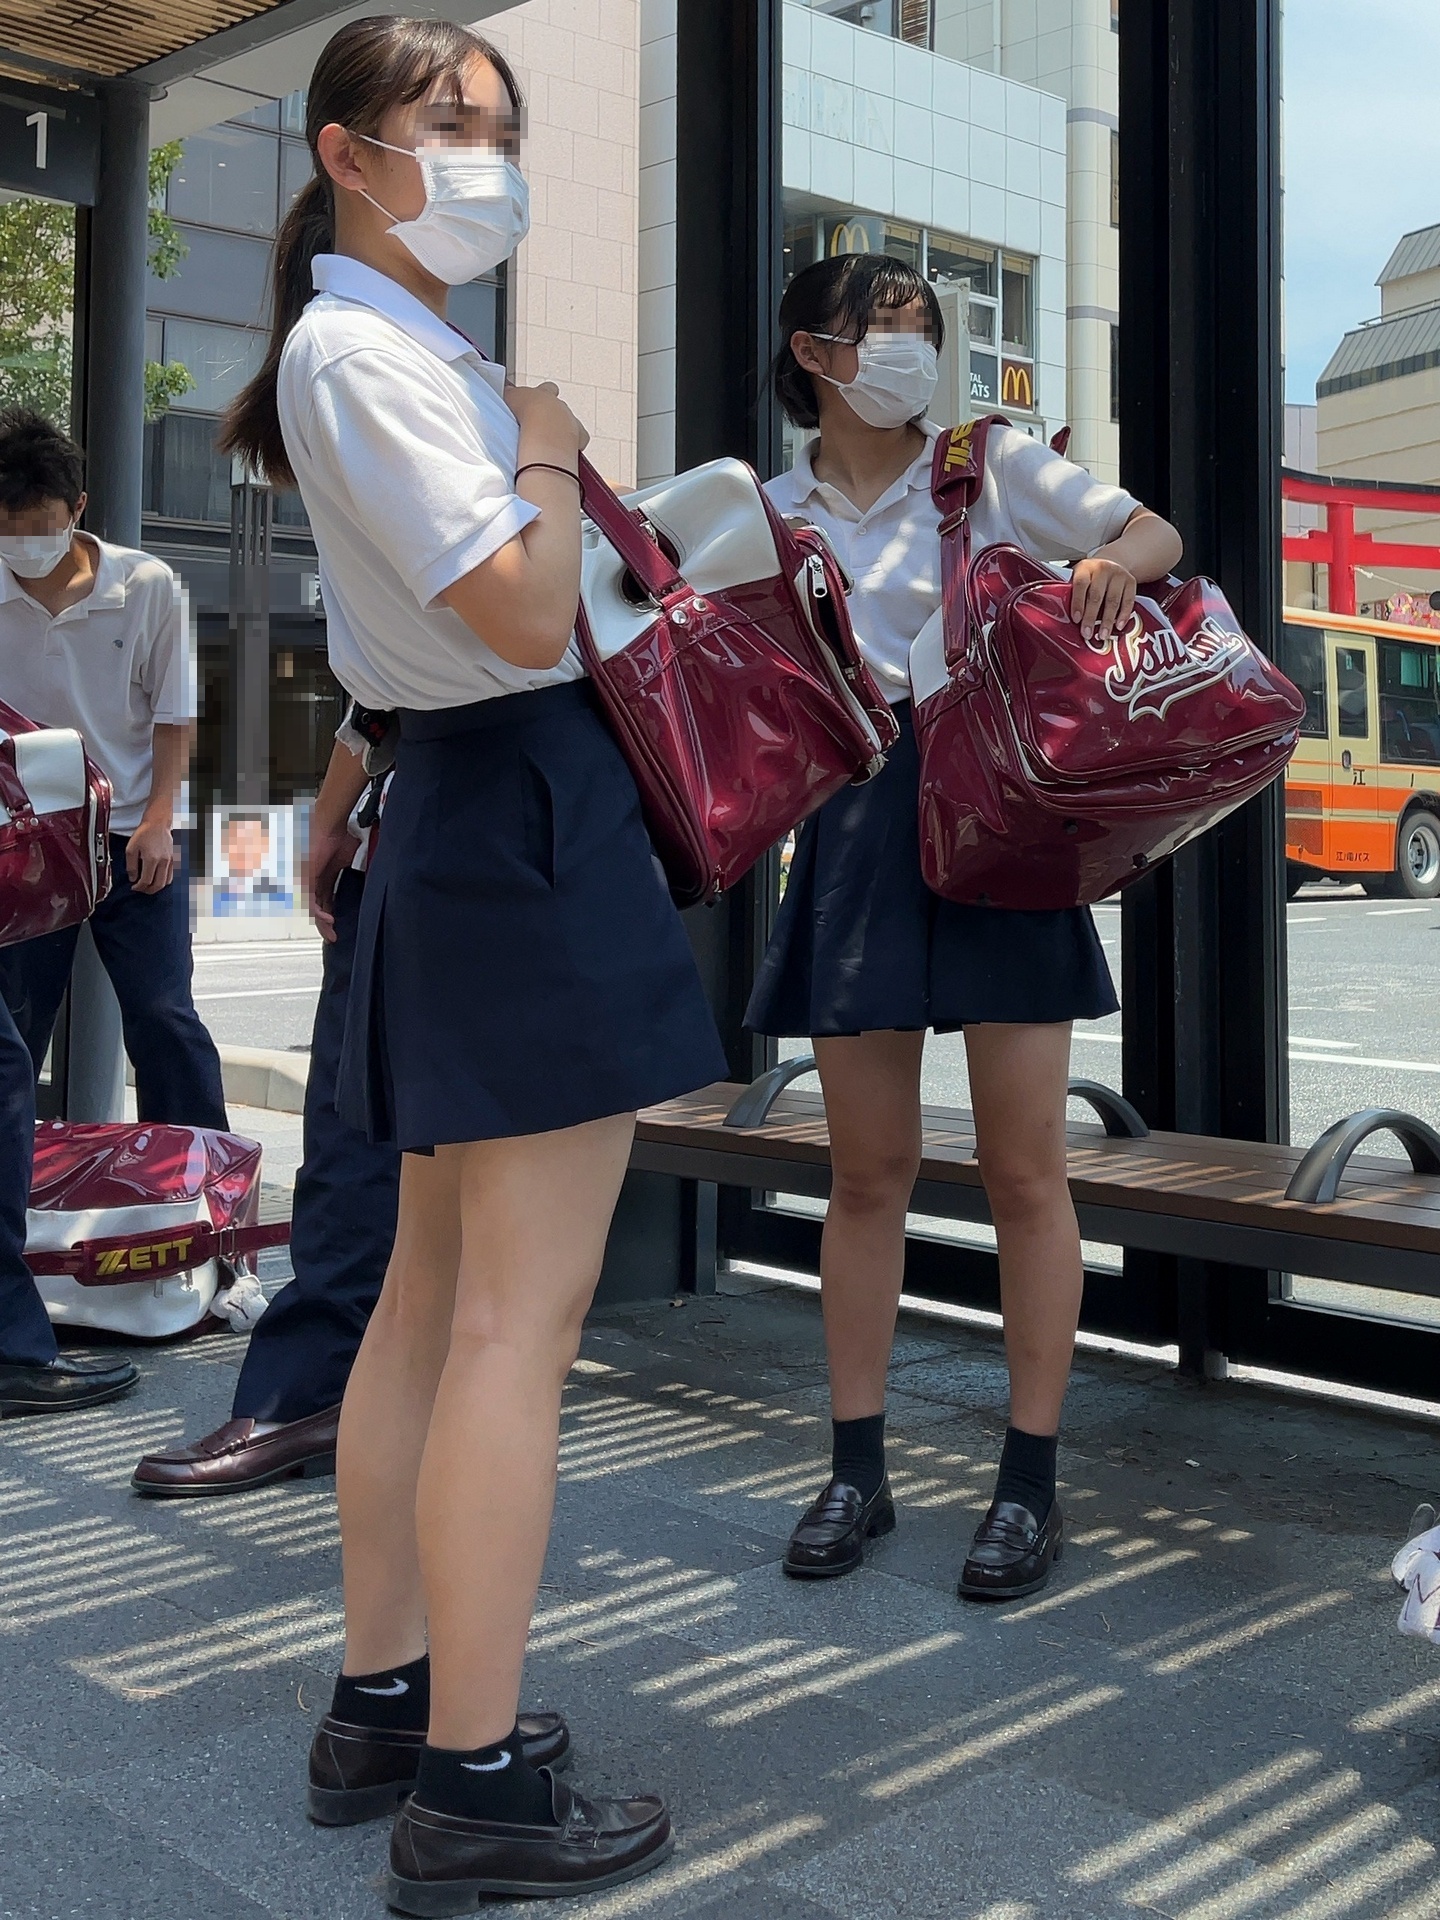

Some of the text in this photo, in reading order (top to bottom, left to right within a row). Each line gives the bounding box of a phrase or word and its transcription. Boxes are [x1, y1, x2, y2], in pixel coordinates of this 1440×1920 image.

[26, 111, 48, 169] 1
[943, 419, 977, 472] ZE
[95, 1236, 194, 1276] ZETT
